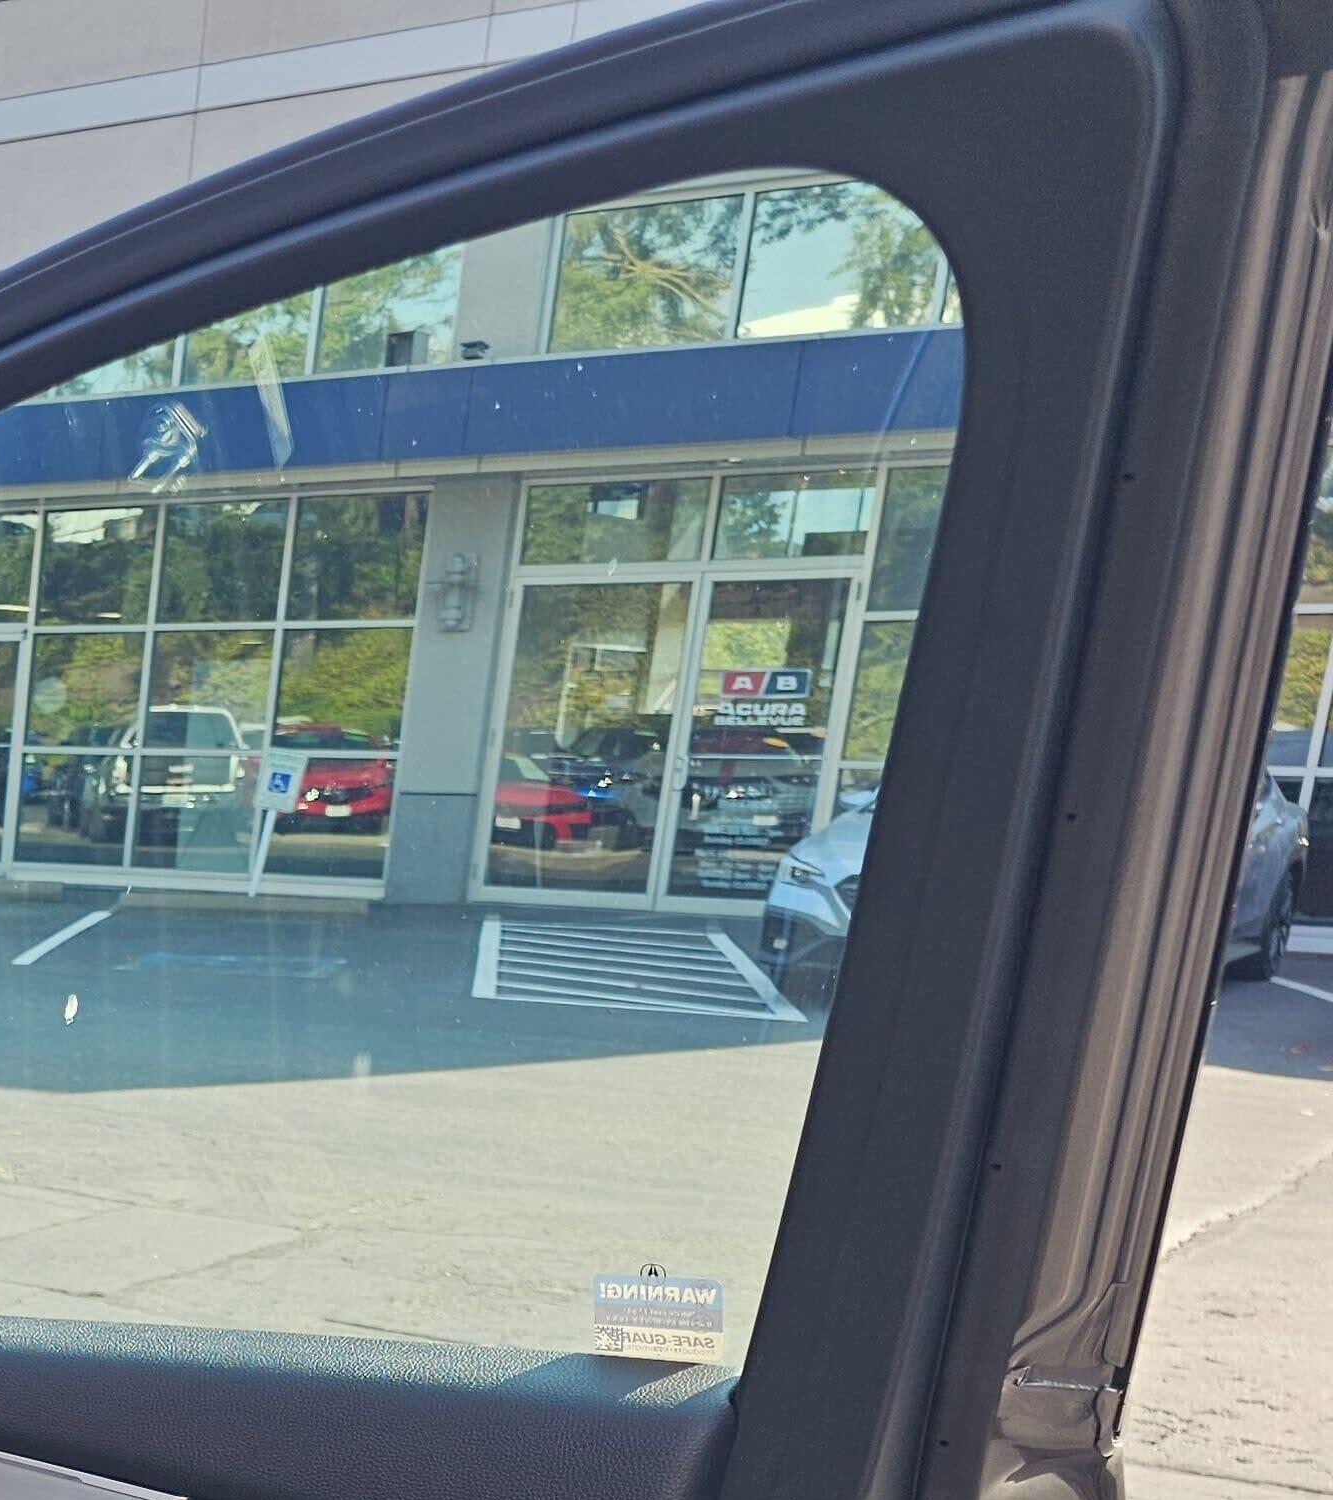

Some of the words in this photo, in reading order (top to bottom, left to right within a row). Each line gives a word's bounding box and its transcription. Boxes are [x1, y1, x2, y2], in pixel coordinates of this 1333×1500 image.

[731, 675, 754, 691] A
[776, 675, 798, 691] B
[717, 701, 807, 716] ACURA
[713, 714, 806, 727] BELLEVUE
